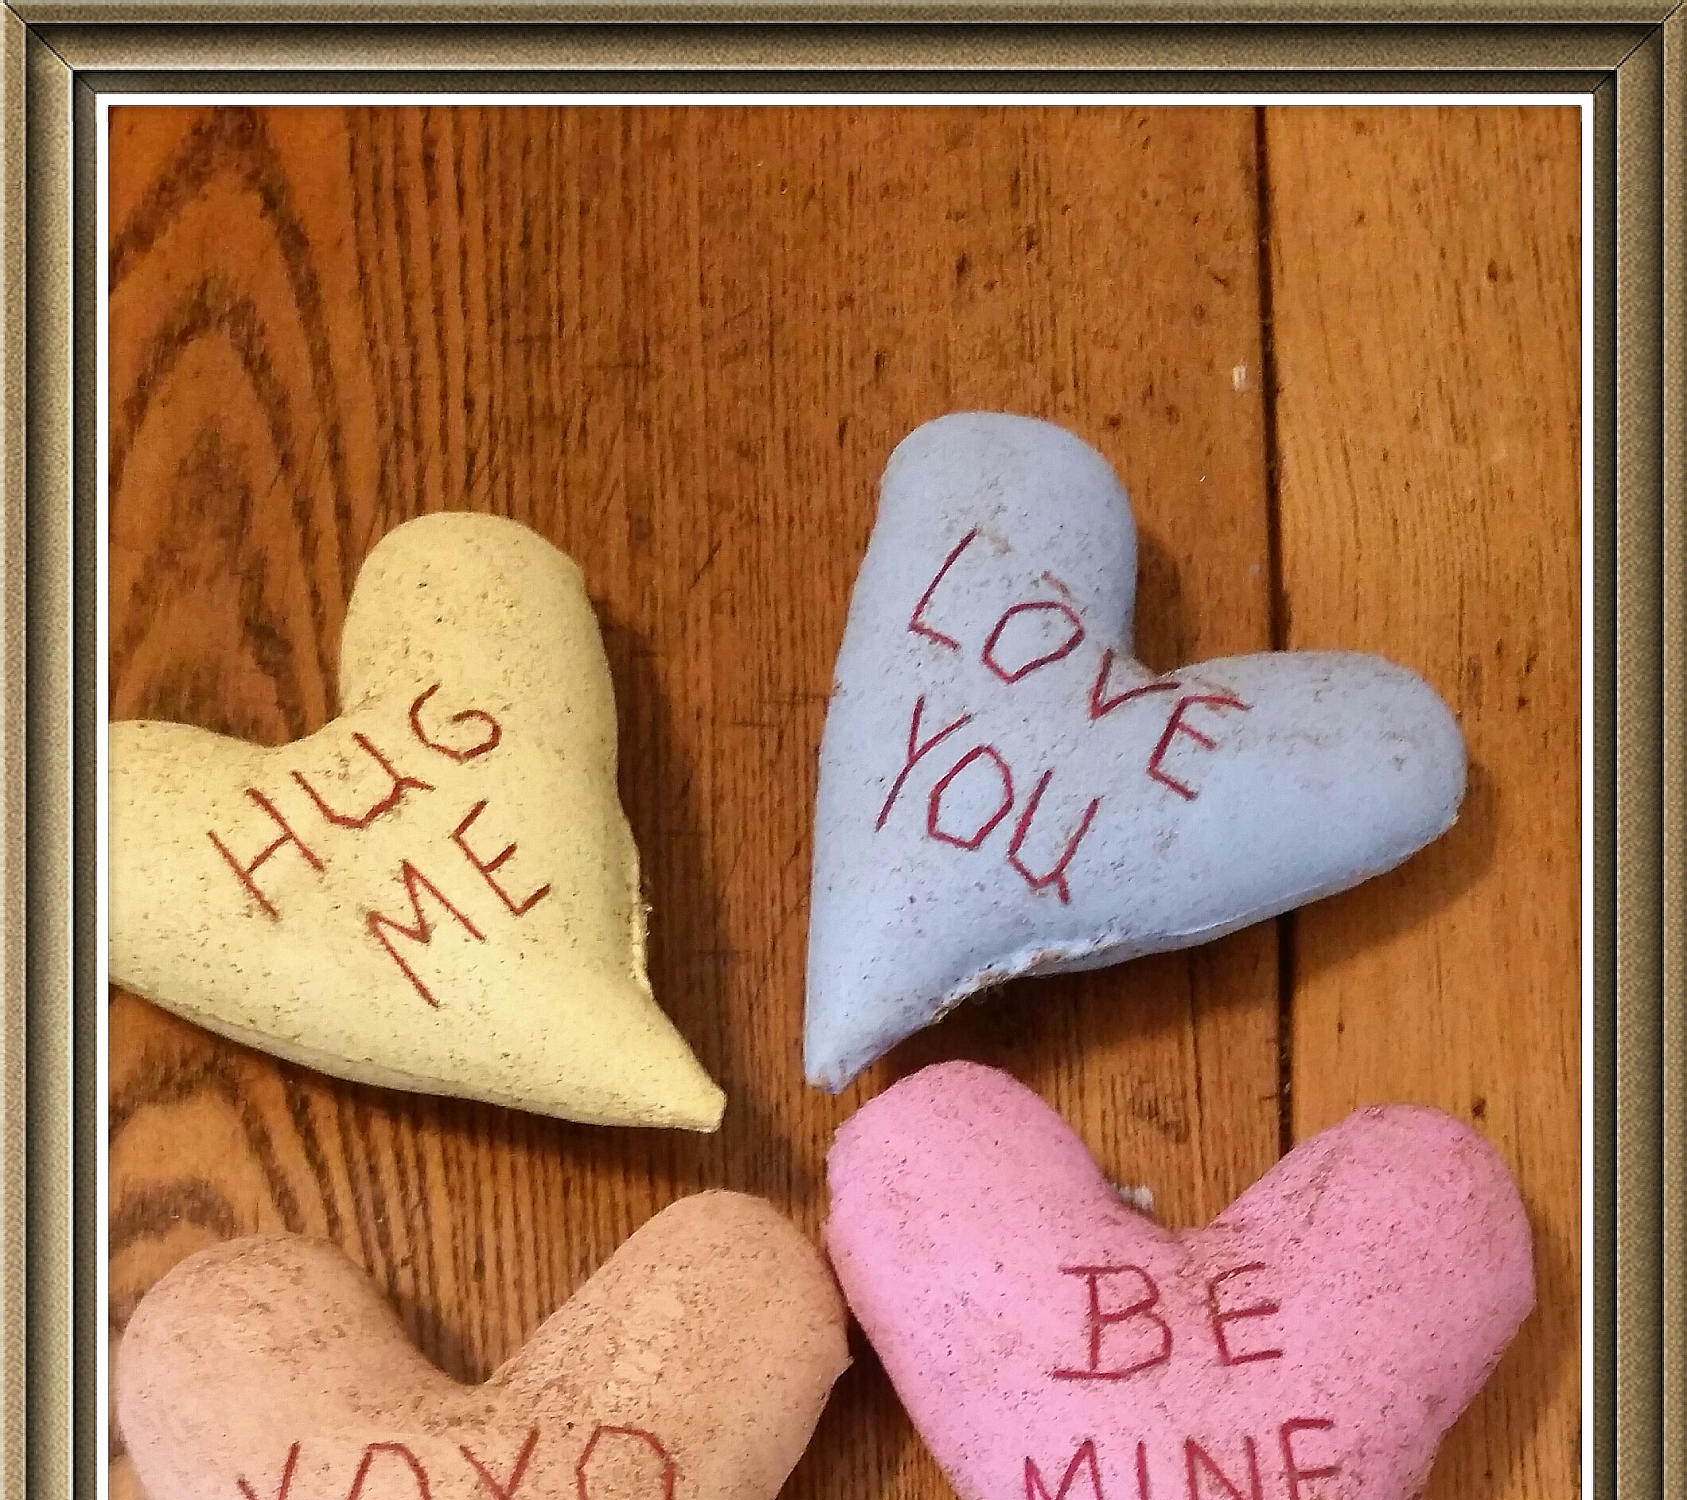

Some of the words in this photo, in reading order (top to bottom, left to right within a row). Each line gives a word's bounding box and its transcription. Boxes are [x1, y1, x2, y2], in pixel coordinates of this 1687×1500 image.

[908, 526, 1254, 800] LOVE
[207, 681, 501, 921] HUG
[875, 695, 1103, 903] YOU
[367, 800, 551, 1008] ME
[1052, 1262, 1282, 1380] BE
